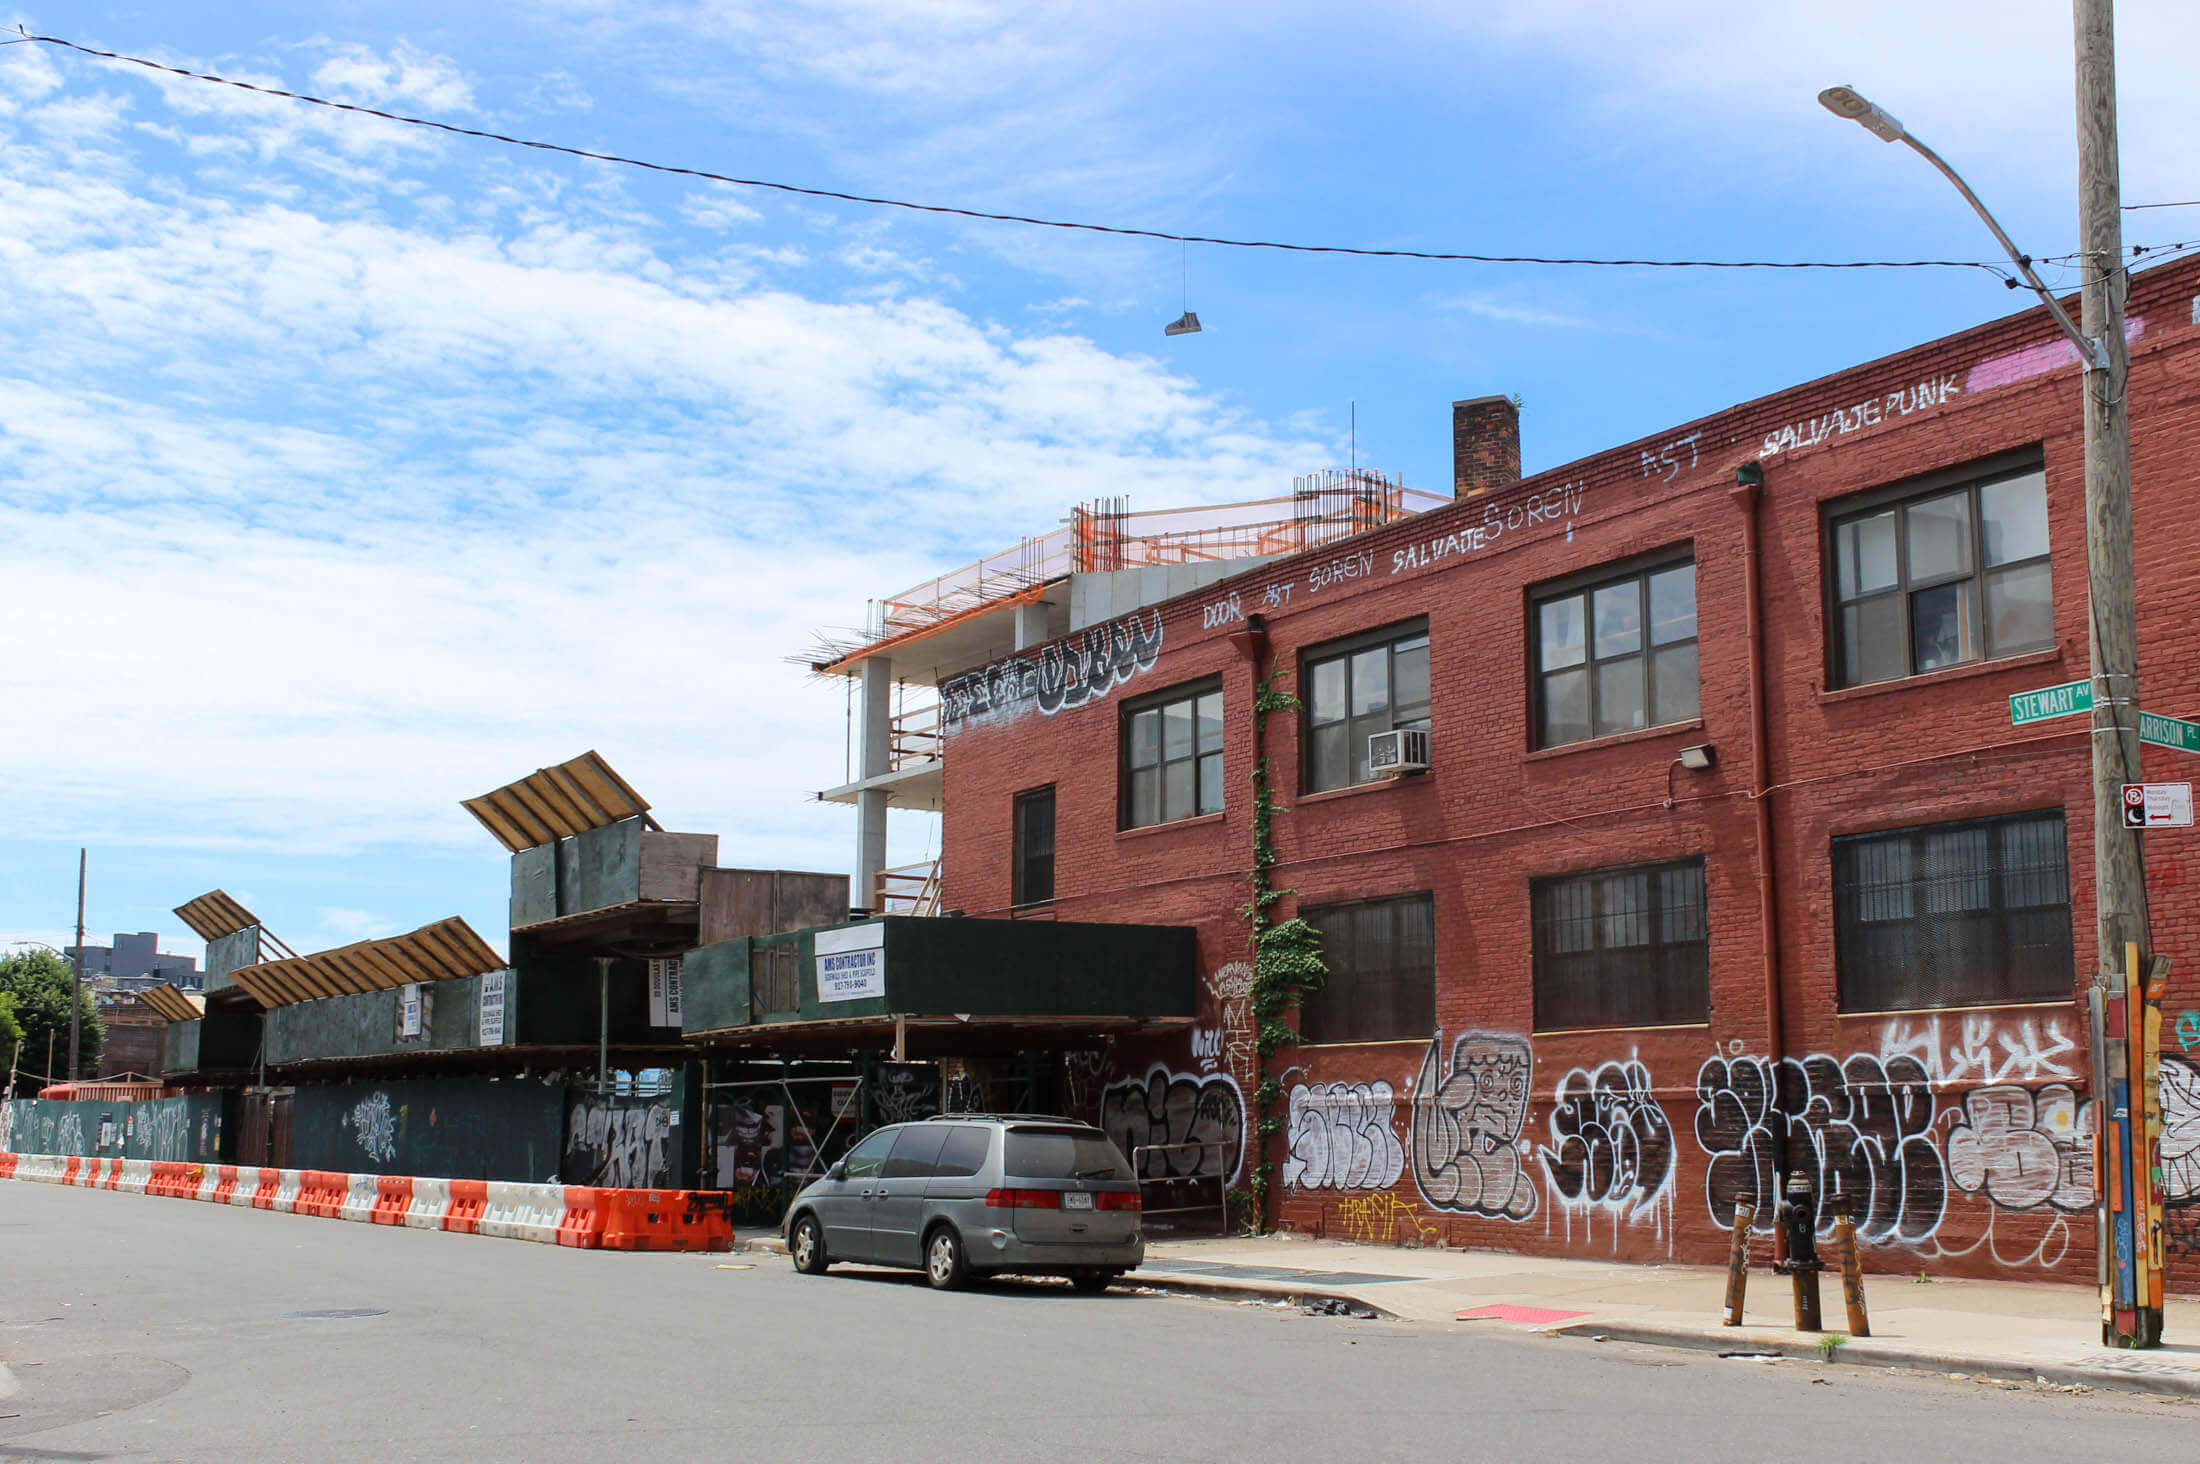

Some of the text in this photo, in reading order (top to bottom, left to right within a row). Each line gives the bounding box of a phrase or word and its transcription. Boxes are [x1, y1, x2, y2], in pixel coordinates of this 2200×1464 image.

[1885, 374, 1960, 421] PUNK
[1483, 479, 1584, 541] SOREN
[1309, 548, 1374, 593] SOREN
[2014, 684, 2090, 720] STEWART AV
[2140, 716, 2197, 746] ARRISON PL
[824, 951, 876, 972] AMS CONTRACTOR INC
[669, 996, 680, 1014] AMS
